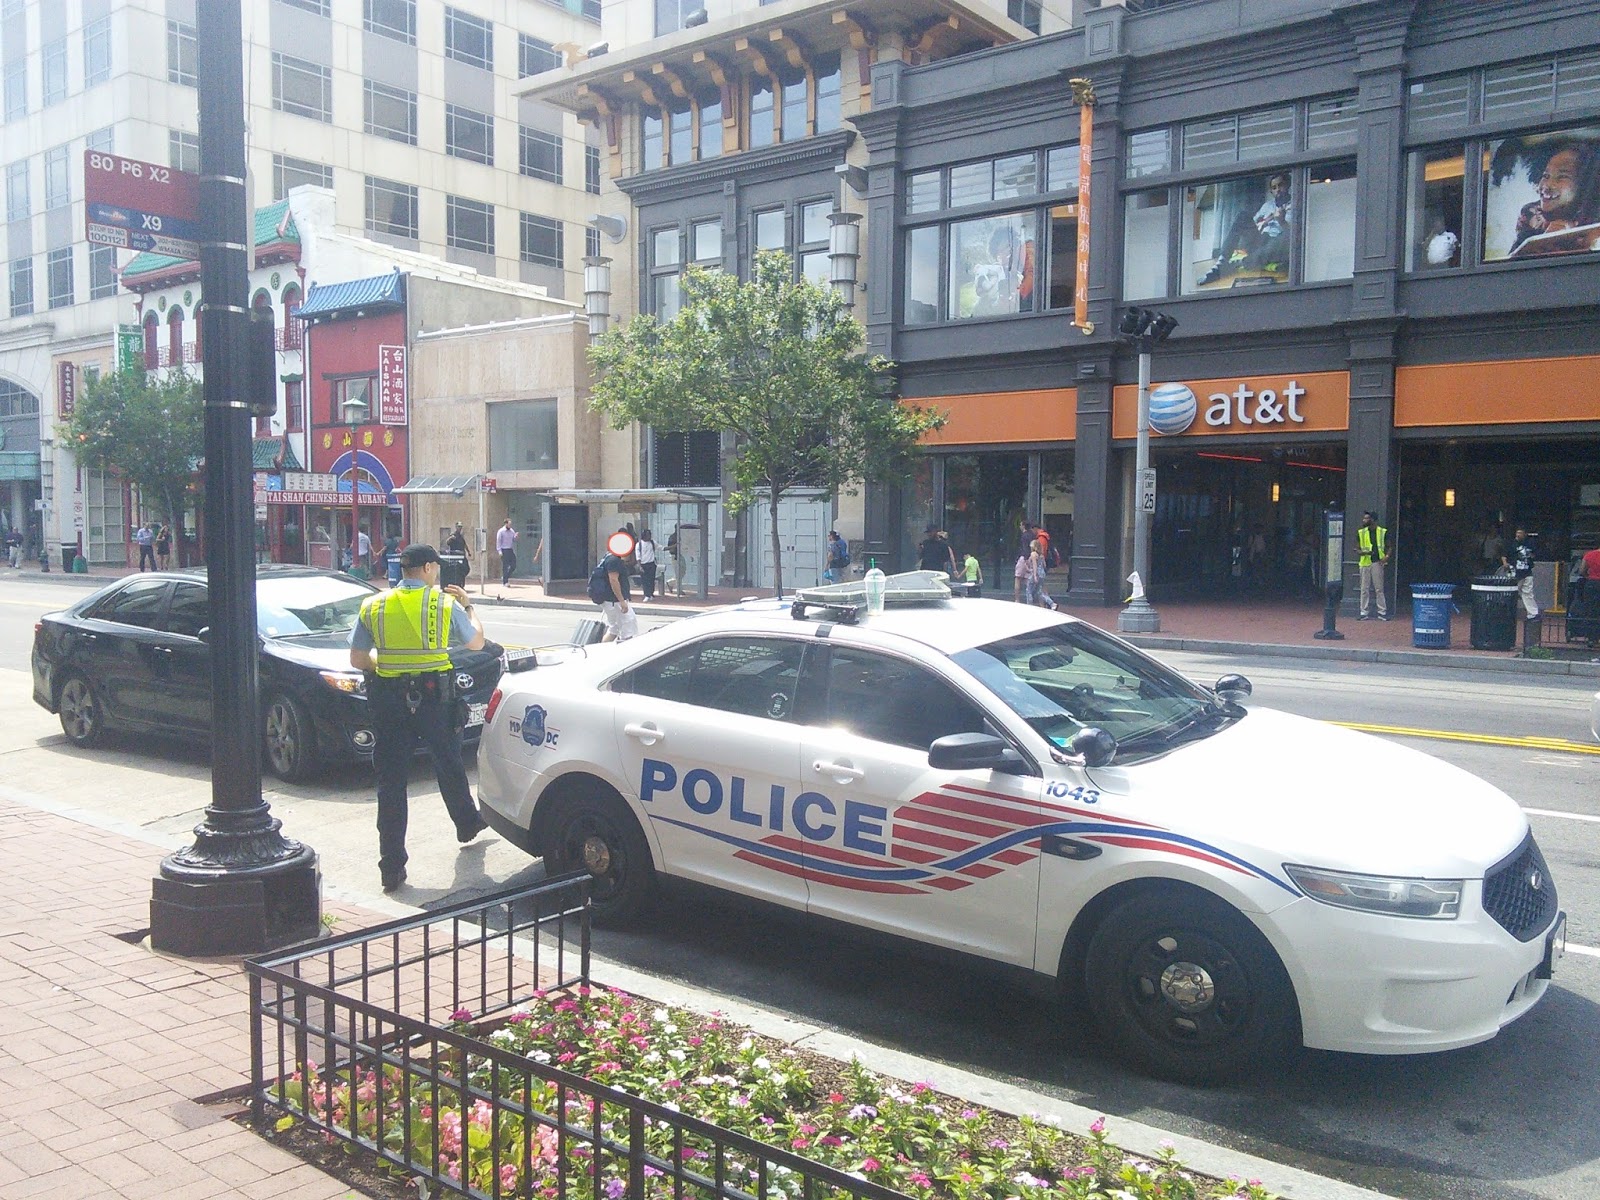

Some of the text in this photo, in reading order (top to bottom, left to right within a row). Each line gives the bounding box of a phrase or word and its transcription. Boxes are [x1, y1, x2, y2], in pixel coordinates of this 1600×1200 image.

[90, 153, 170, 184] 80 P6 X2
[89, 225, 105, 233] STOP
[141, 214, 162, 231] X9
[90, 233, 126, 245] 1001121
[392, 349, 403, 405] 台山酒家
[1204, 380, 1306, 426] at&t
[305, 492, 338, 503] CHINESE
[338, 493, 387, 504] RESAURANT
[1144, 493, 1154, 509] 25
[428, 597, 437, 643] POLICE
[509, 720, 560, 746] MP DC
[1046, 781, 1100, 804] 1043
[640, 758, 888, 856] POLICE
